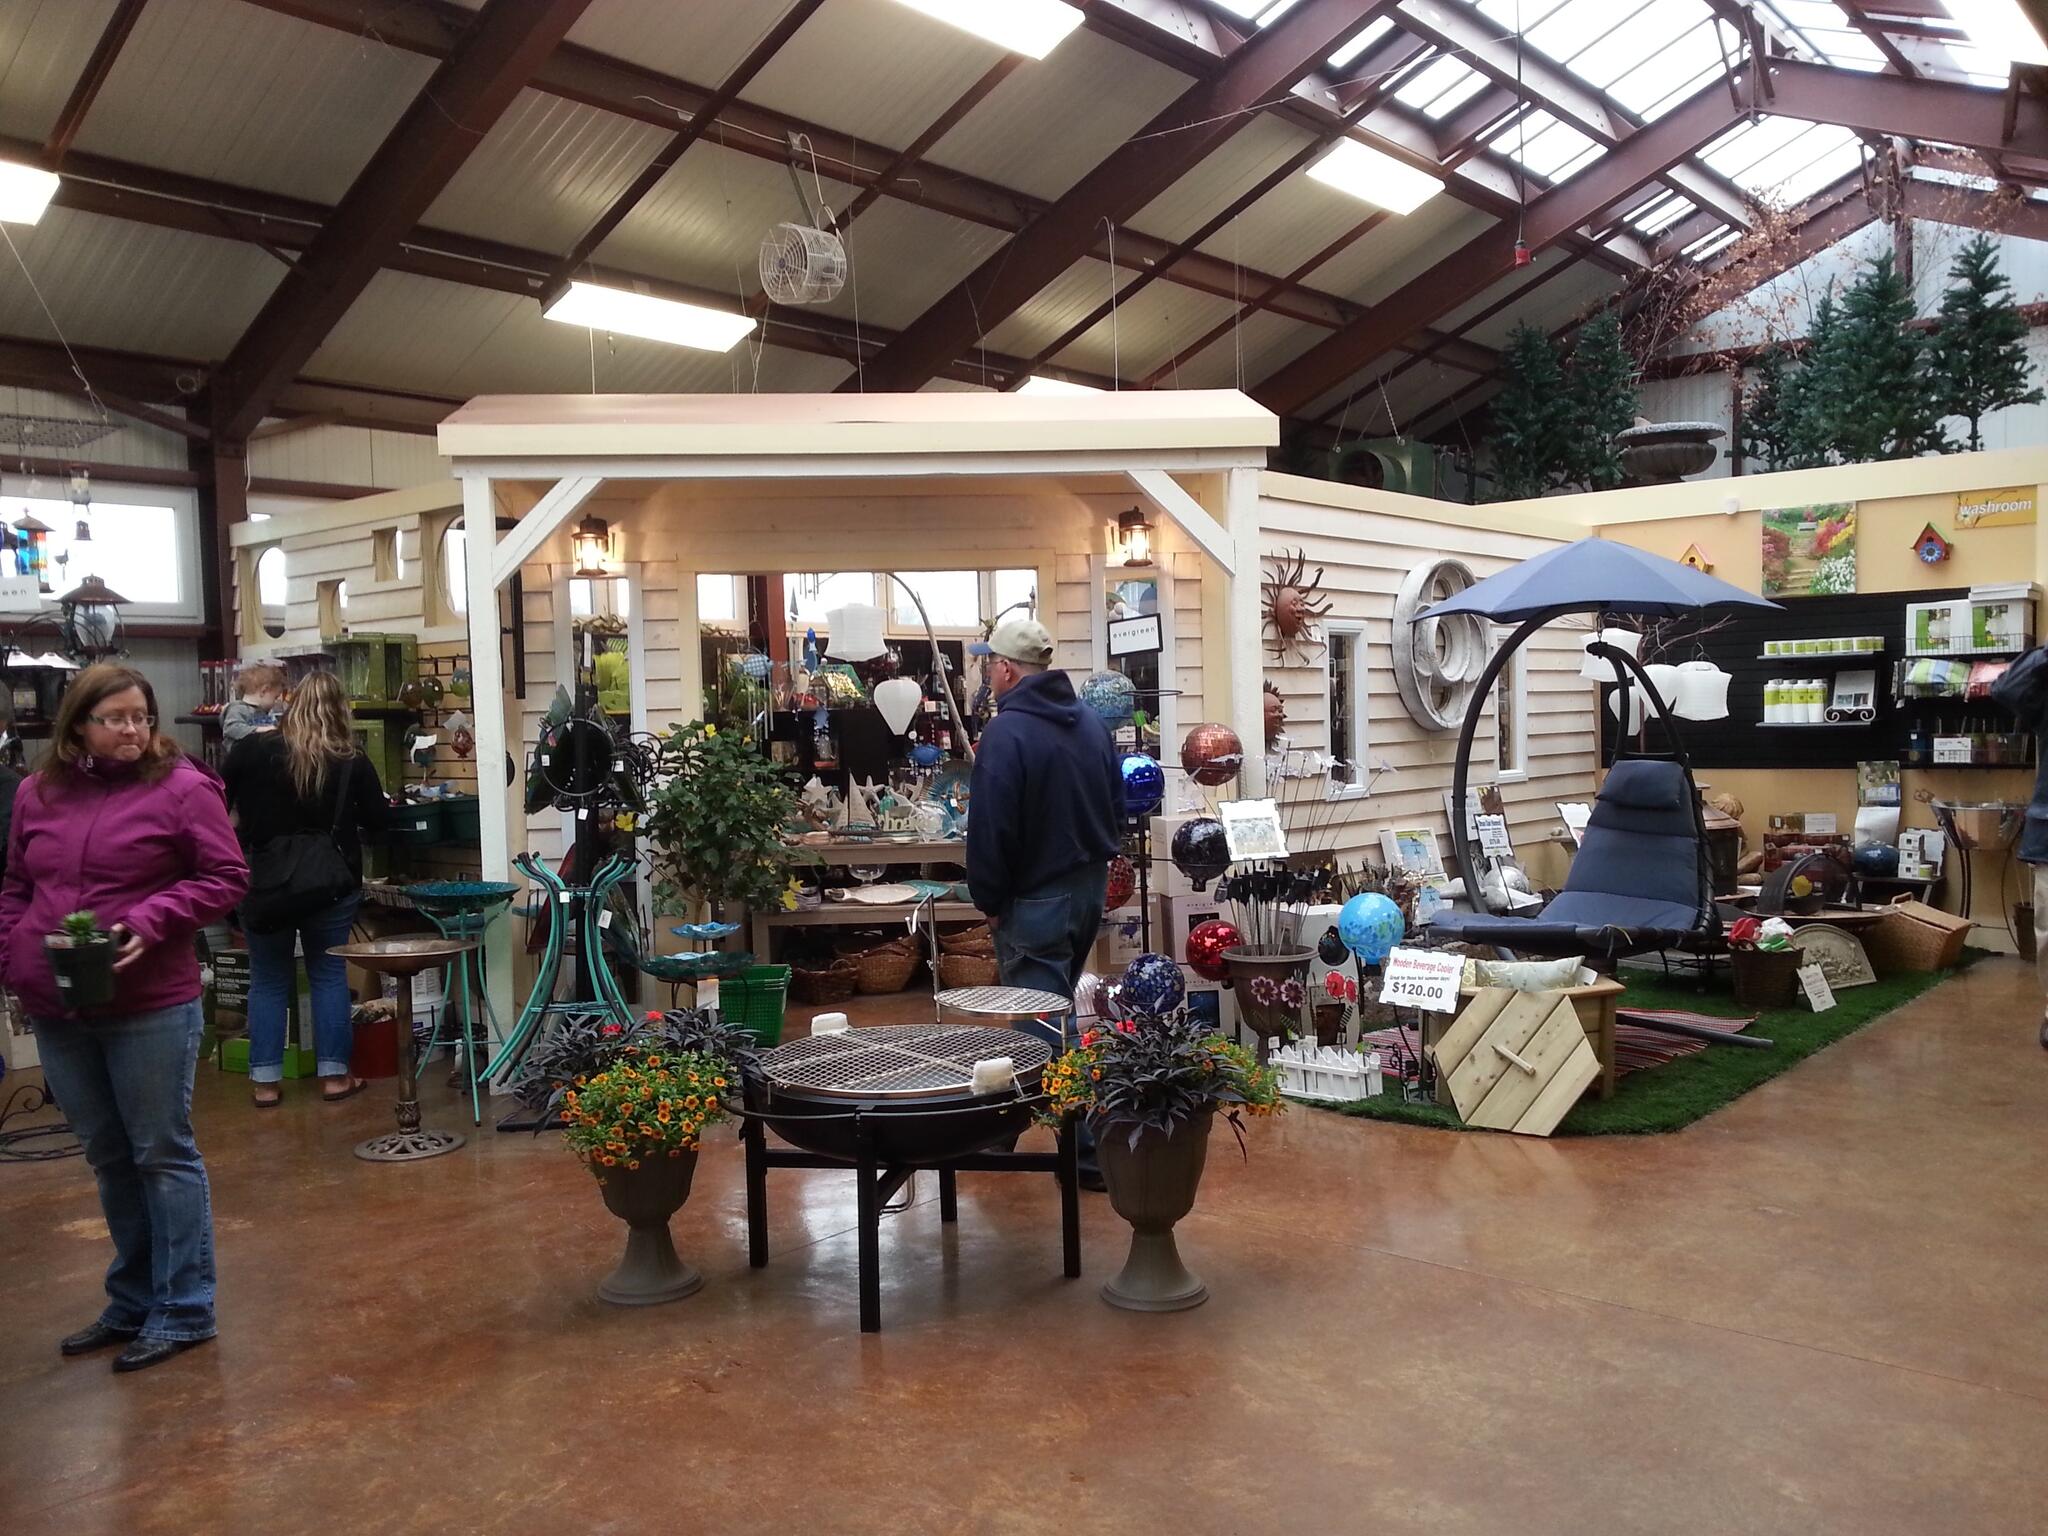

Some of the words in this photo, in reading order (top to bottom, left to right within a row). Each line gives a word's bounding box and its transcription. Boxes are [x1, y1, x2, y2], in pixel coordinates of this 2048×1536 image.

[1960, 500, 2032, 515] washroom
[1113, 627, 1155, 638] evergreen
[1392, 957, 1412, 969] Wooden
[1412, 959, 1436, 973] Beverage
[1437, 962, 1454, 974] Cooler
[1392, 981, 1443, 999] $120.00
